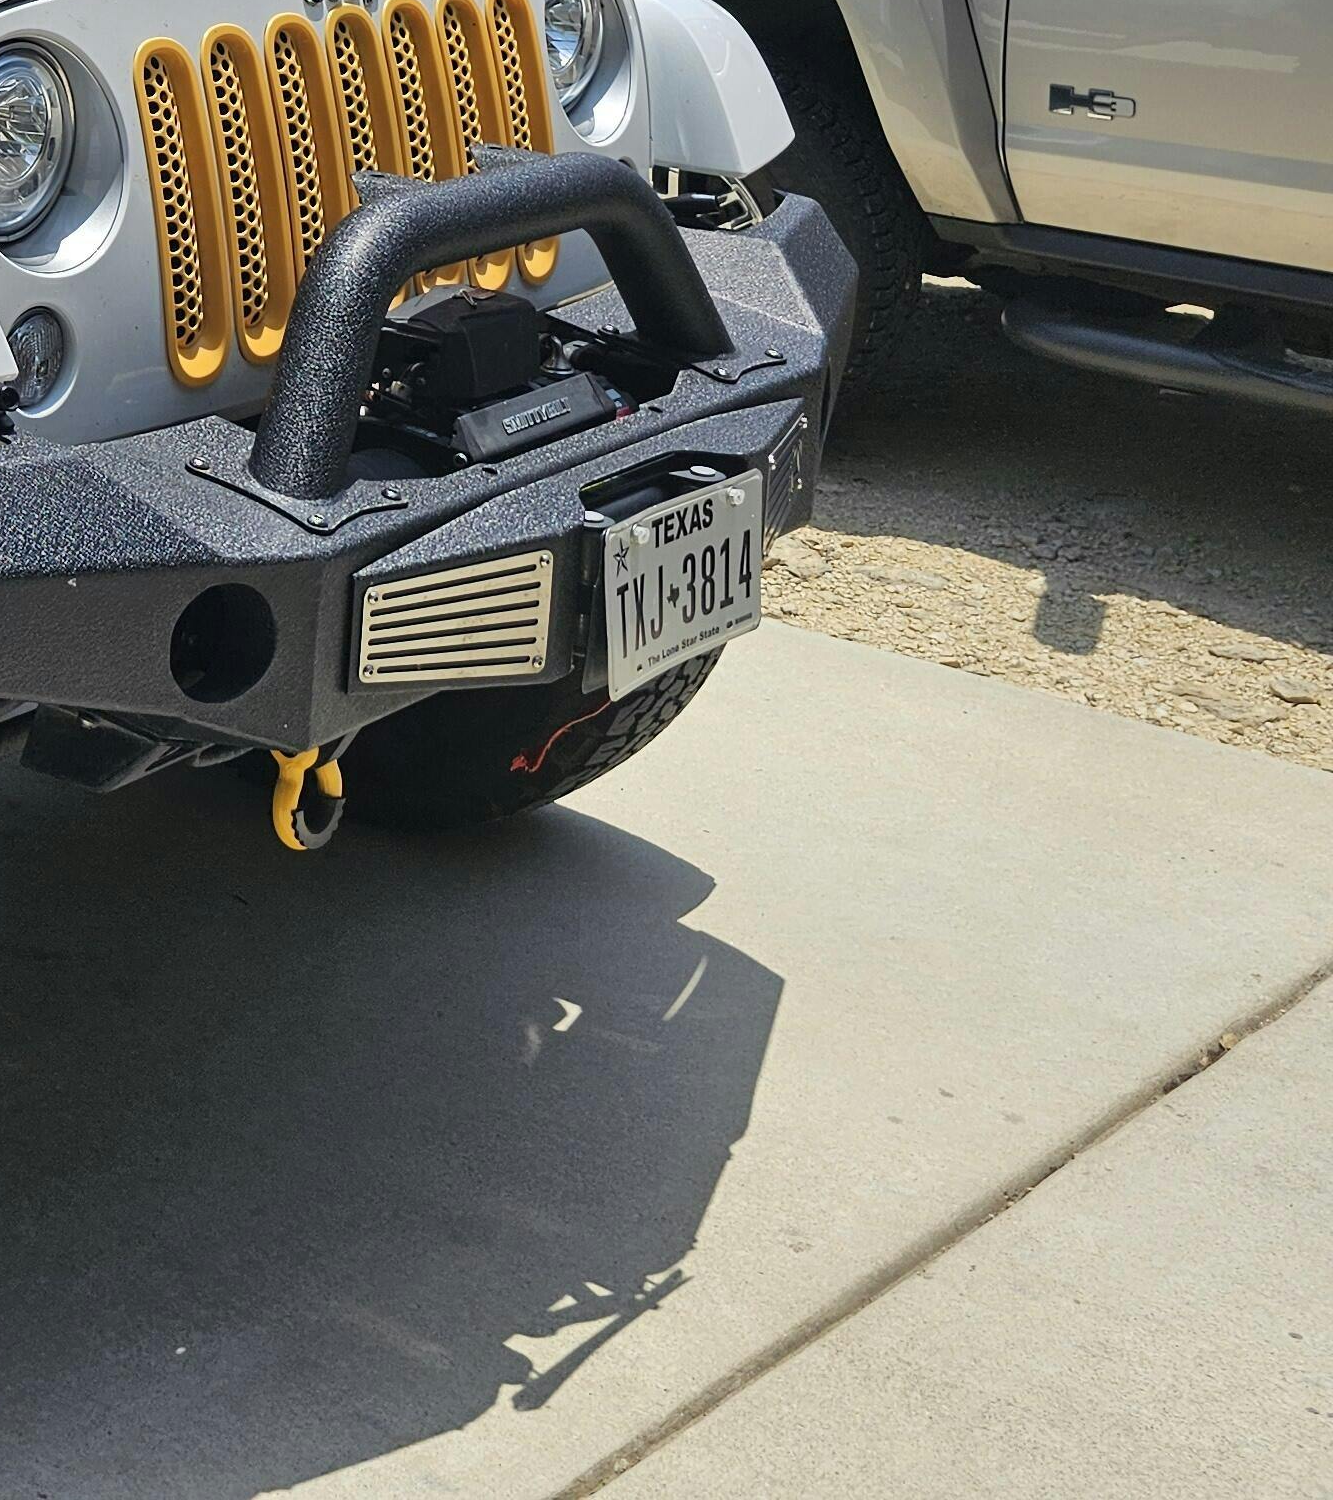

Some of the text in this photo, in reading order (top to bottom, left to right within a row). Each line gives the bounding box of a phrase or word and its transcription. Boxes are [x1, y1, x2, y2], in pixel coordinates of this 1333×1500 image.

[651, 498, 714, 548] TEXAS
[616, 529, 752, 659] TXJ 3814
[648, 626, 720, 667] The Lone Star State
